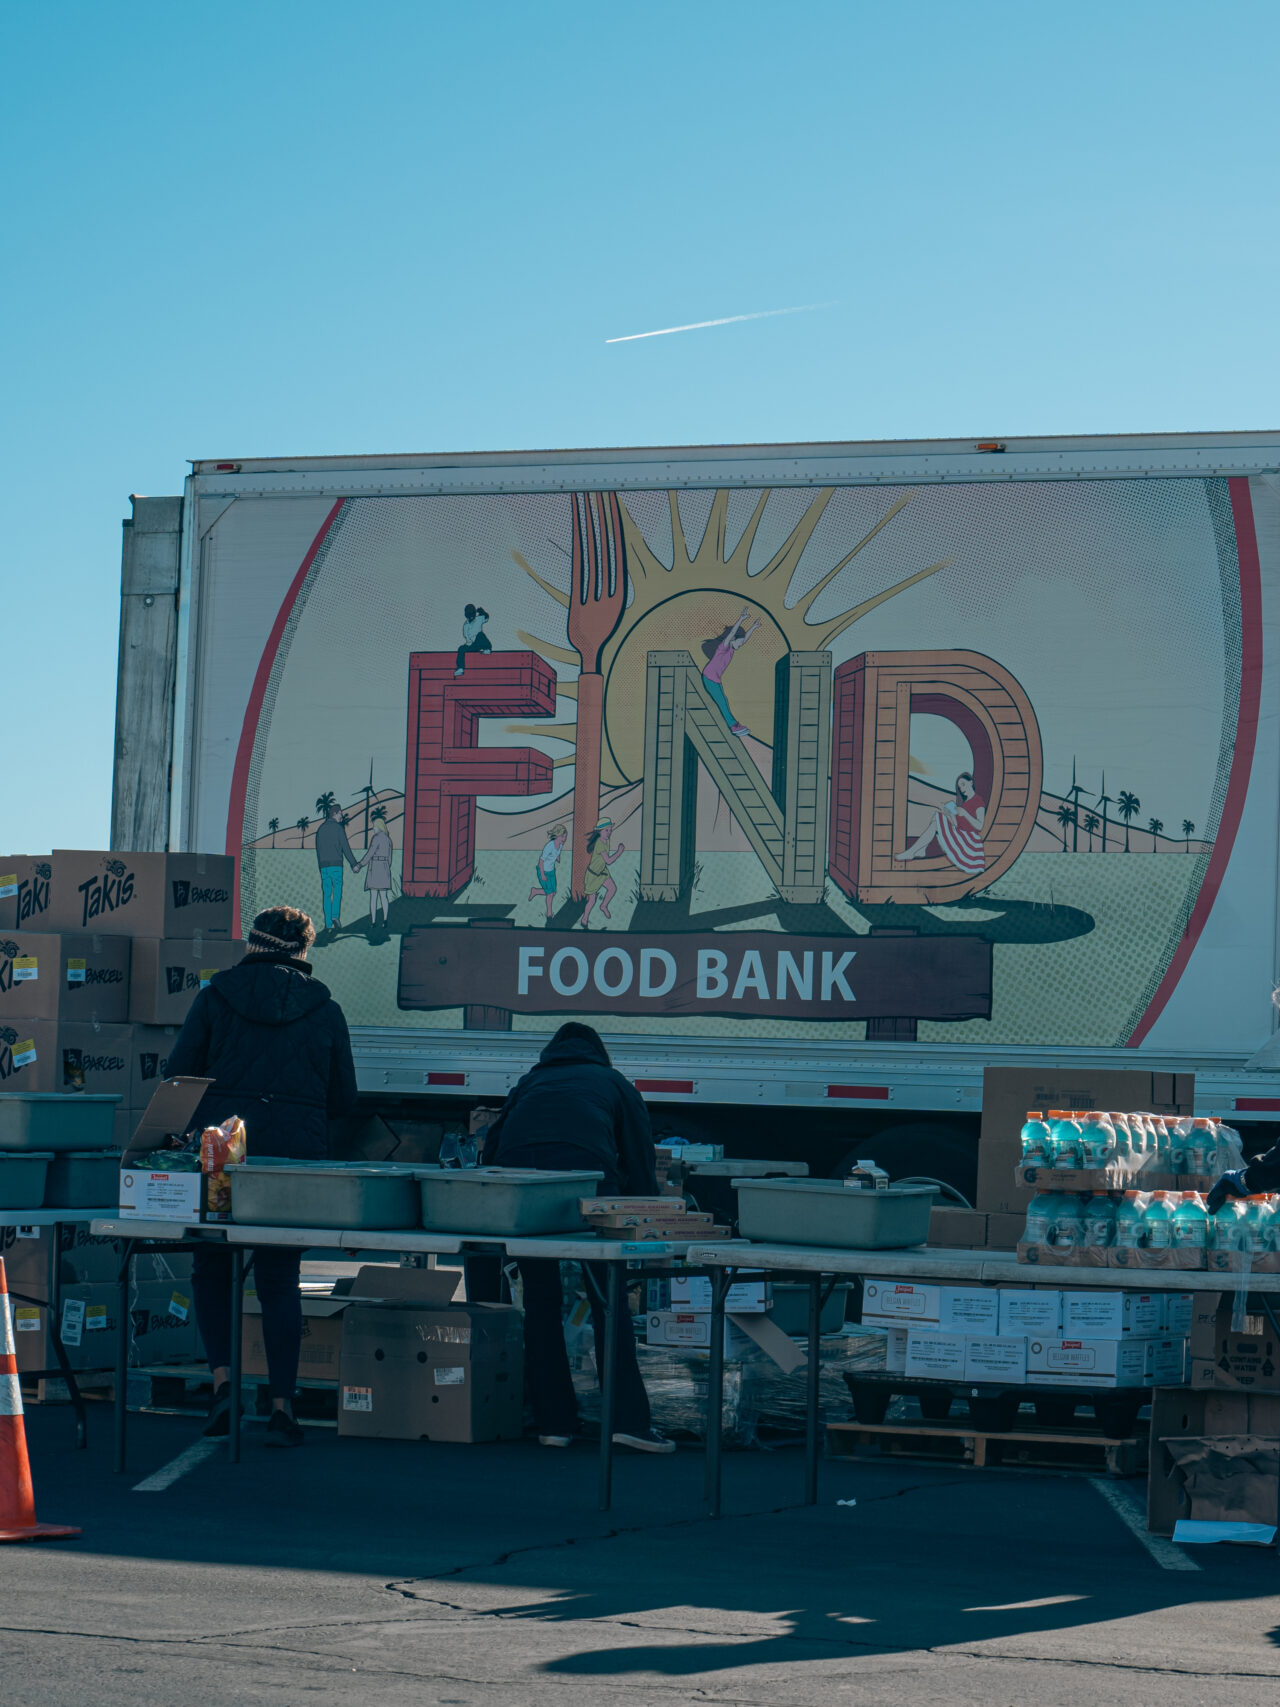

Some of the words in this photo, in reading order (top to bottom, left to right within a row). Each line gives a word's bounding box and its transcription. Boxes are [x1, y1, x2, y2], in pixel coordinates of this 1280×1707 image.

[17, 877, 51, 929] Taki
[191, 887, 226, 903] BARCEL
[517, 945, 678, 998] FOOD
[696, 948, 858, 1002] BANK
[83, 1055, 124, 1072] BARCEL
